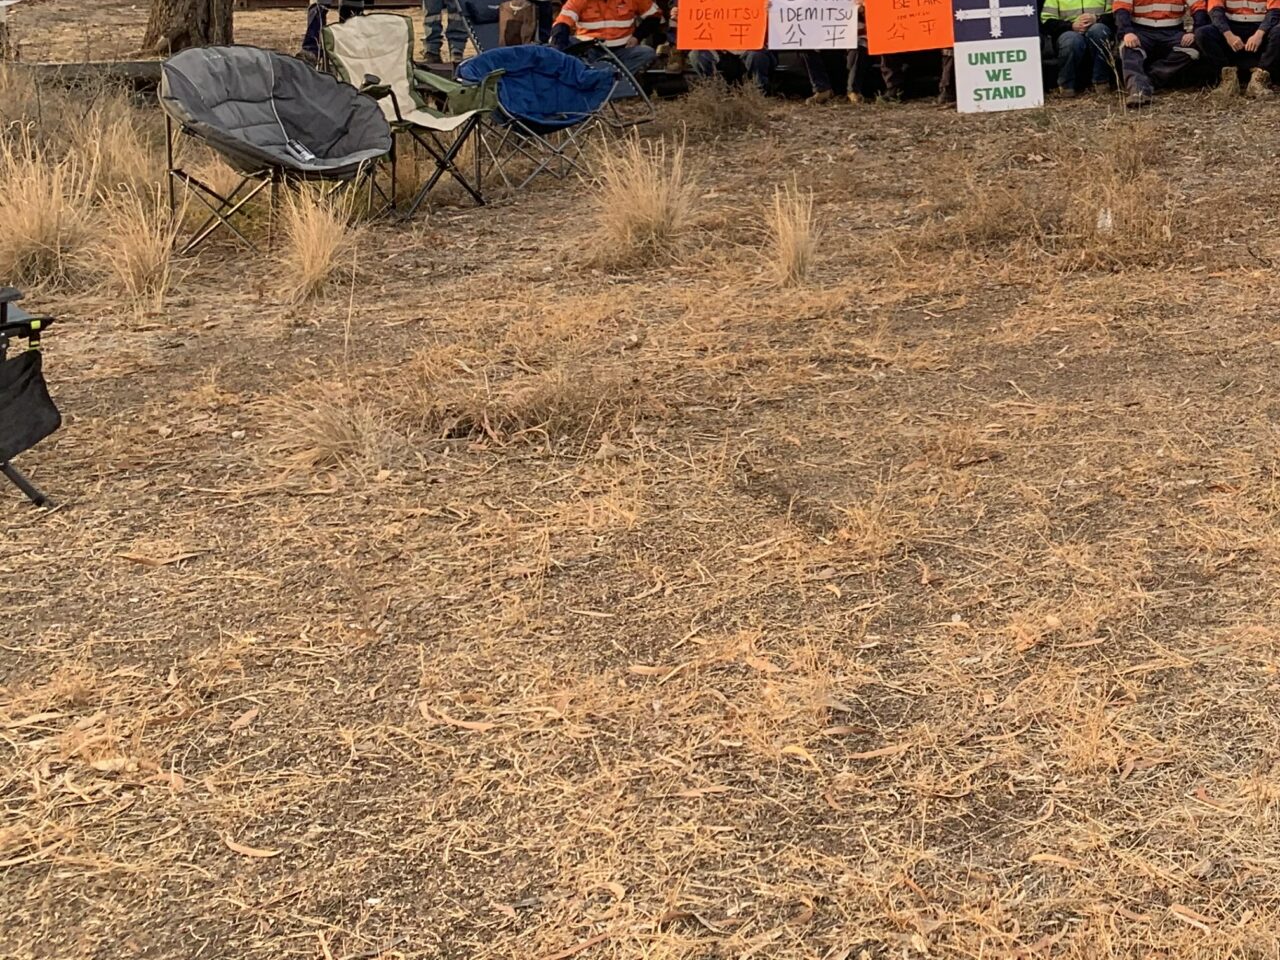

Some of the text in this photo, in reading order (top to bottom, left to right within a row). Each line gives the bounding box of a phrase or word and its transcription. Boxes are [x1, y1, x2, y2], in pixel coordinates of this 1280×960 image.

[688, 7, 760, 20] IDEMITSU
[779, 7, 853, 23] IDEMITSU
[693, 22, 752, 44] 公平
[781, 24, 849, 47] 公平
[968, 49, 1027, 66] UNITED
[985, 68, 1013, 82] WE
[973, 85, 1026, 101] STAND
